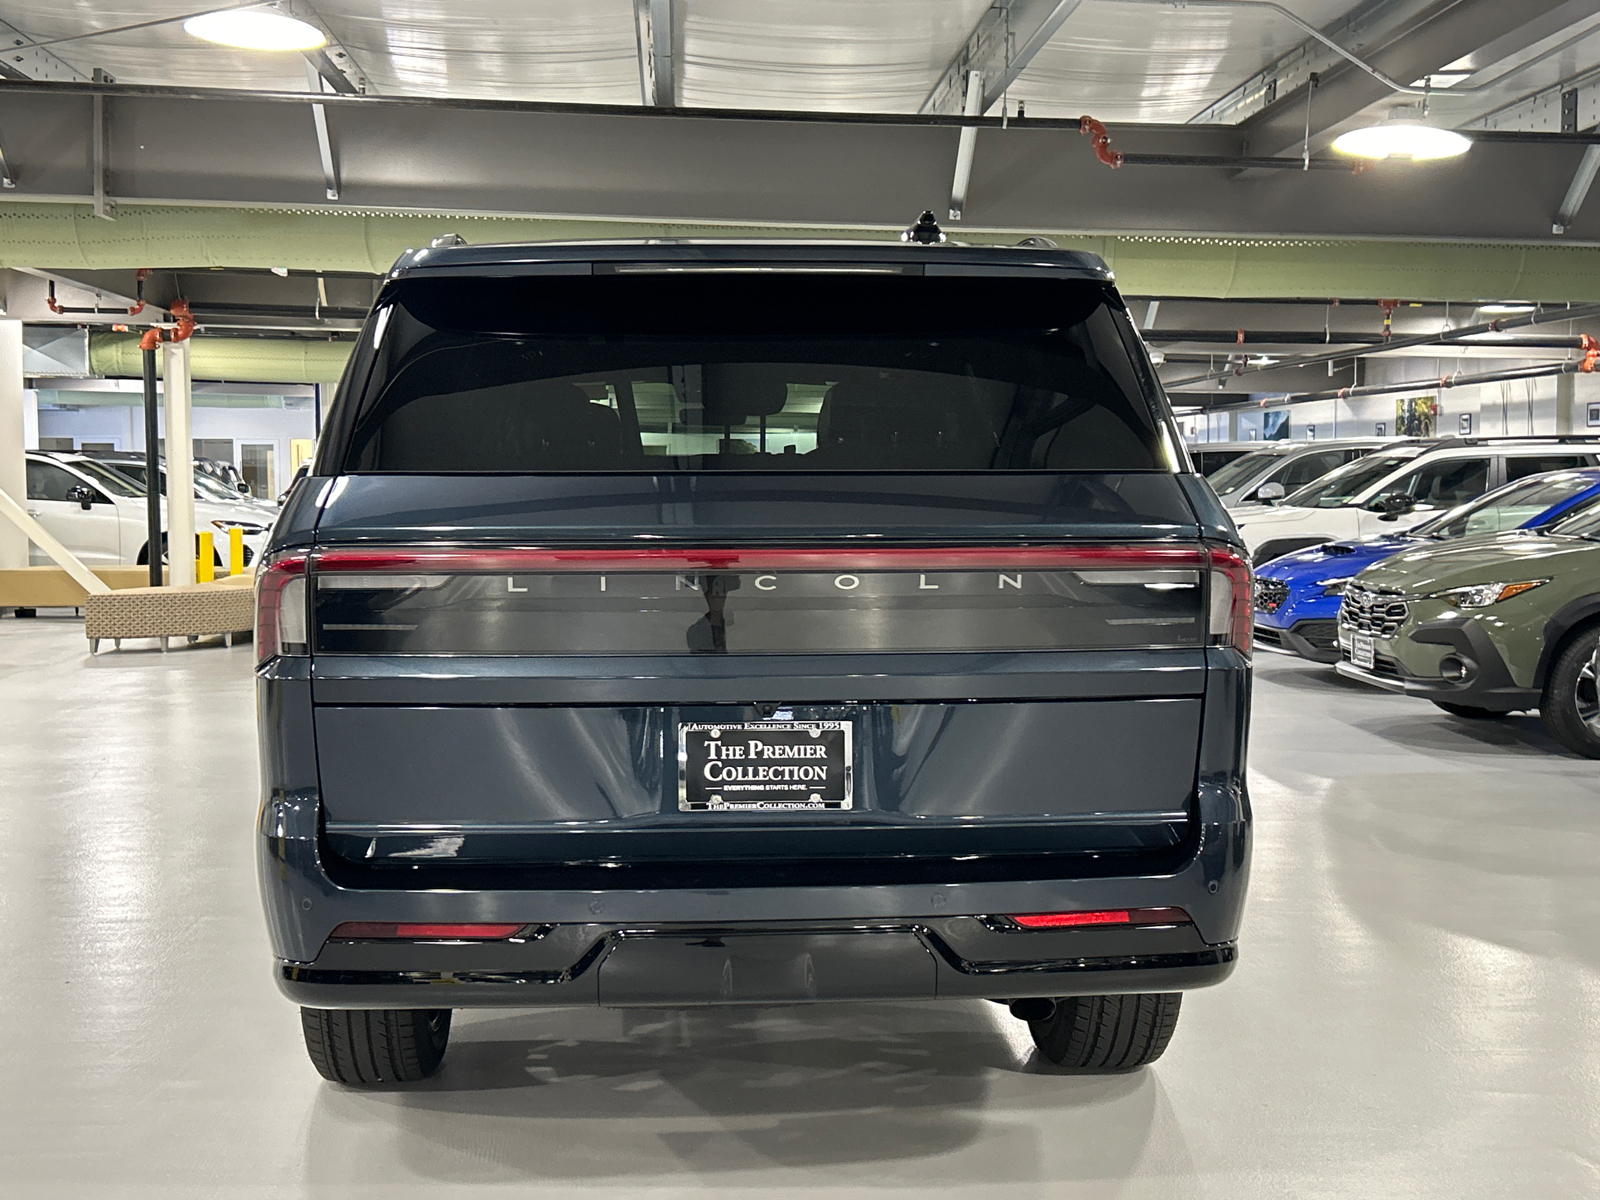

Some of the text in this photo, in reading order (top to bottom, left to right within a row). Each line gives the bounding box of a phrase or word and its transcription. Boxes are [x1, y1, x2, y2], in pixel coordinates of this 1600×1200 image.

[507, 573, 1023, 593] LINCOLN
[744, 722, 791, 730] EXCELLENCE
[793, 722, 817, 730] SINCE
[818, 722, 840, 730] 1995
[704, 740, 828, 760] THE PREMIER
[704, 761, 828, 782] COLLECTION
